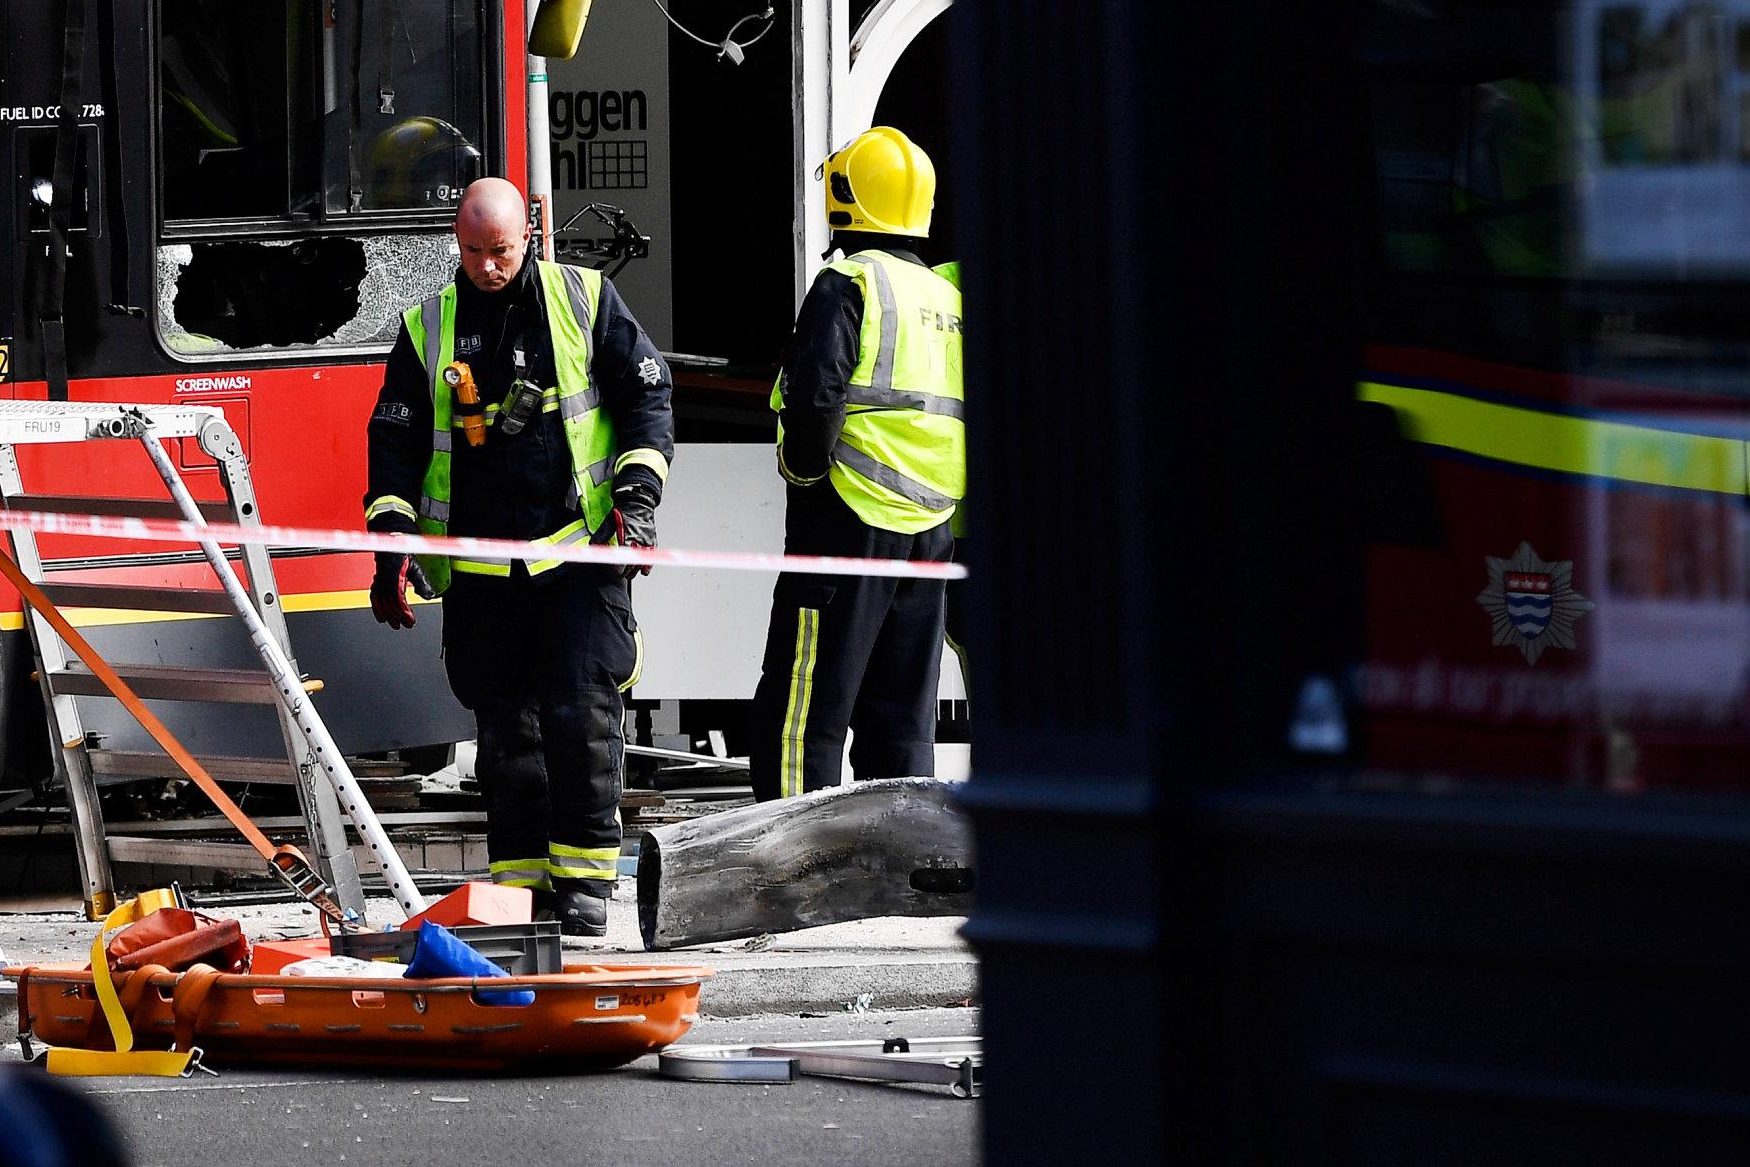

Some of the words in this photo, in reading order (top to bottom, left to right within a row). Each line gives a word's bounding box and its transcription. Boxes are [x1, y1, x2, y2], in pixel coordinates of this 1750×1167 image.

[0, 106, 30, 121] FUEL
[32, 106, 44, 120] ID
[175, 376, 252, 393] SCREENWASH
[24, 420, 62, 434] FRU19
